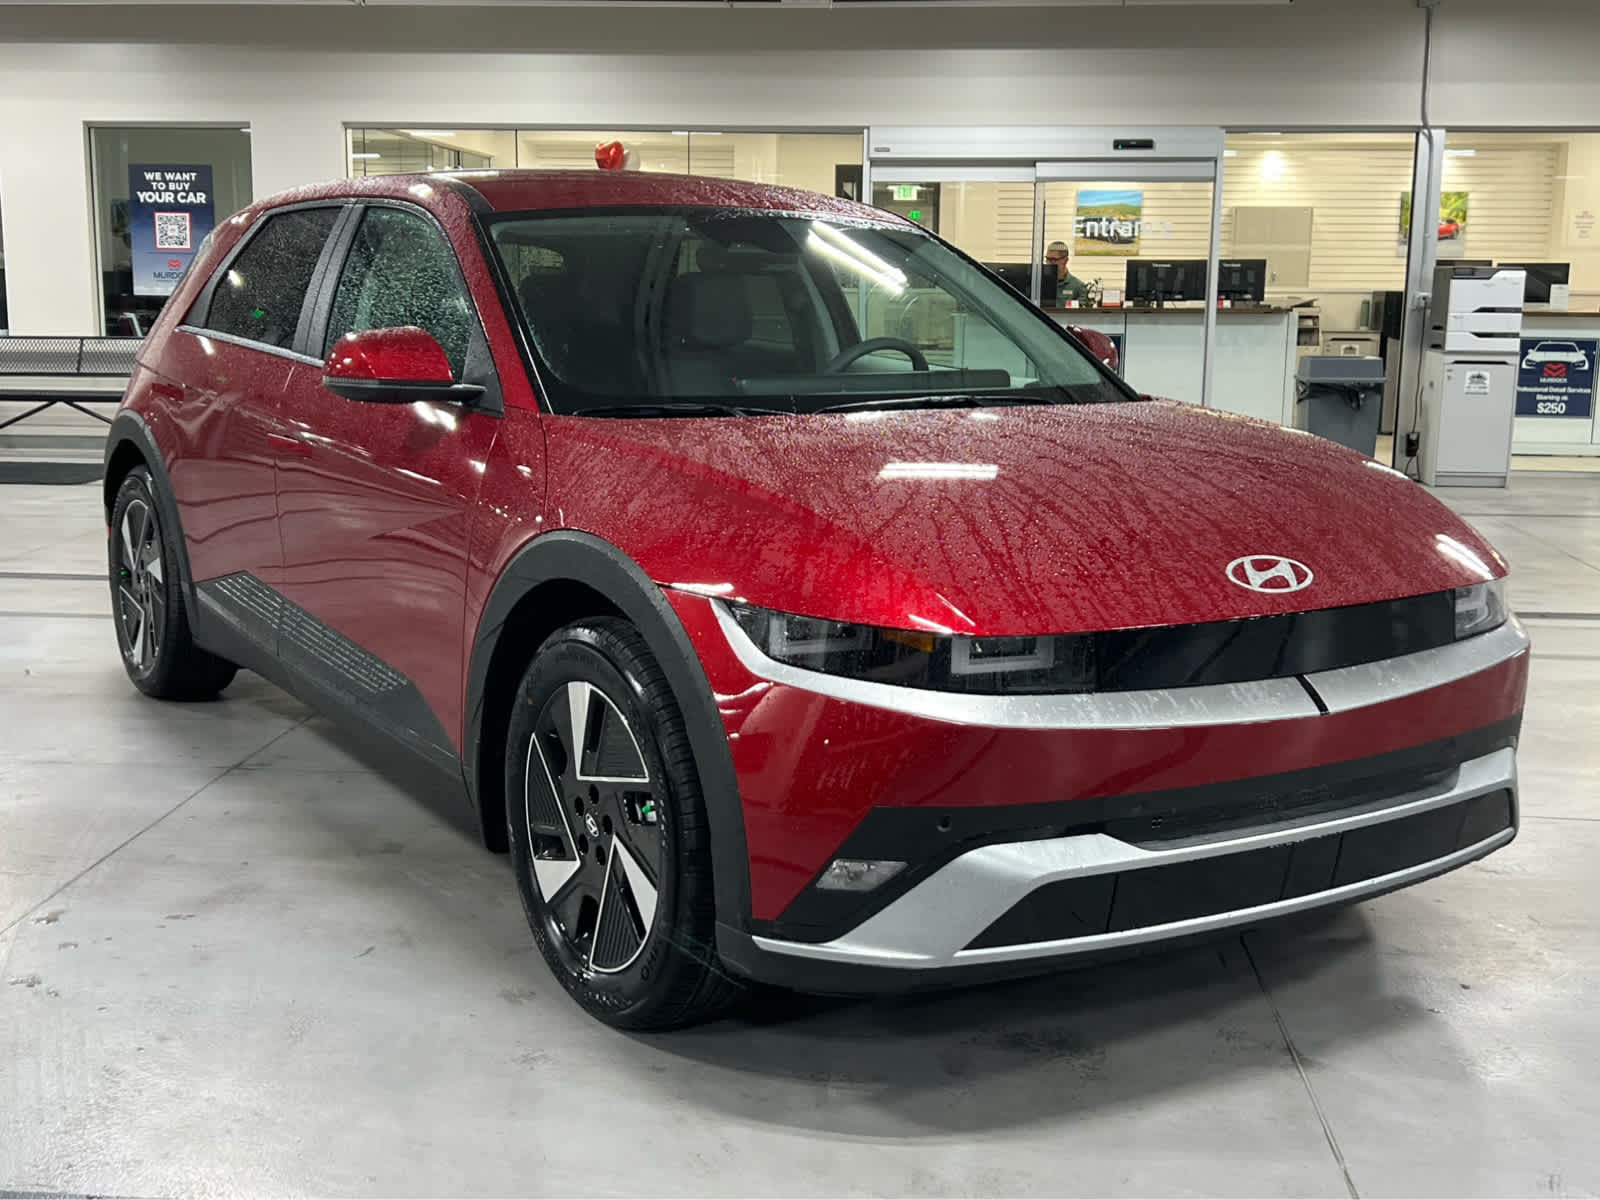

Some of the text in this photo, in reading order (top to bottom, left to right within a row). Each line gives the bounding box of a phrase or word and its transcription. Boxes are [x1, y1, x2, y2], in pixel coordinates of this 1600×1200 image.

[144, 171, 197, 181] WE WANT
[151, 182, 190, 191] TO BUY
[136, 191, 206, 203] YOUR CAR
[153, 272, 185, 280] MURDO
[1536, 402, 1567, 414] $250
